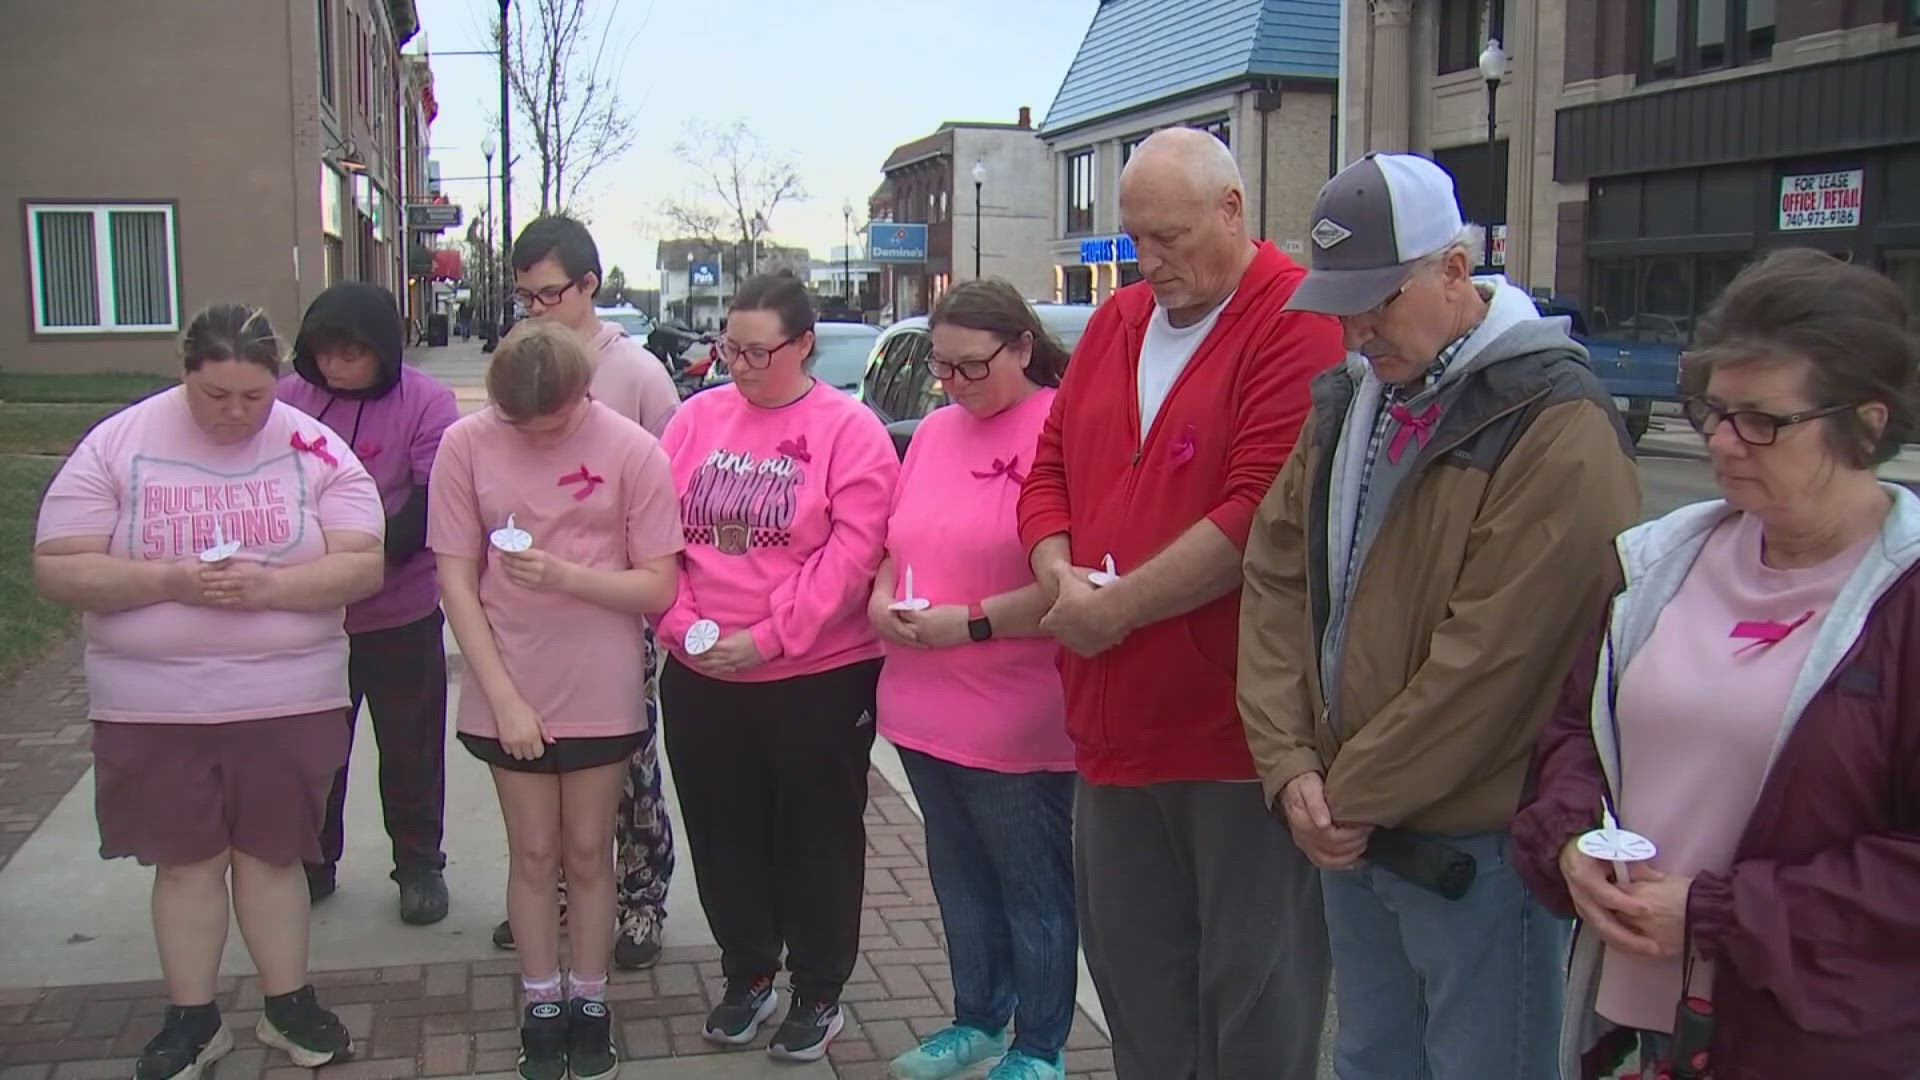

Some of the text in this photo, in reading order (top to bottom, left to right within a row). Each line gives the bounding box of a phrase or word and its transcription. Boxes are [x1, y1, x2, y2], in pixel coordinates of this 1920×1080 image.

[1794, 173, 1849, 191] FOR LEASE
[1785, 210, 1854, 227] 740-973-9186
[872, 246, 924, 259] Domino's
[701, 448, 796, 477] pink out
[143, 478, 286, 519] BUCKEYE
[142, 505, 291, 561] STRONG
